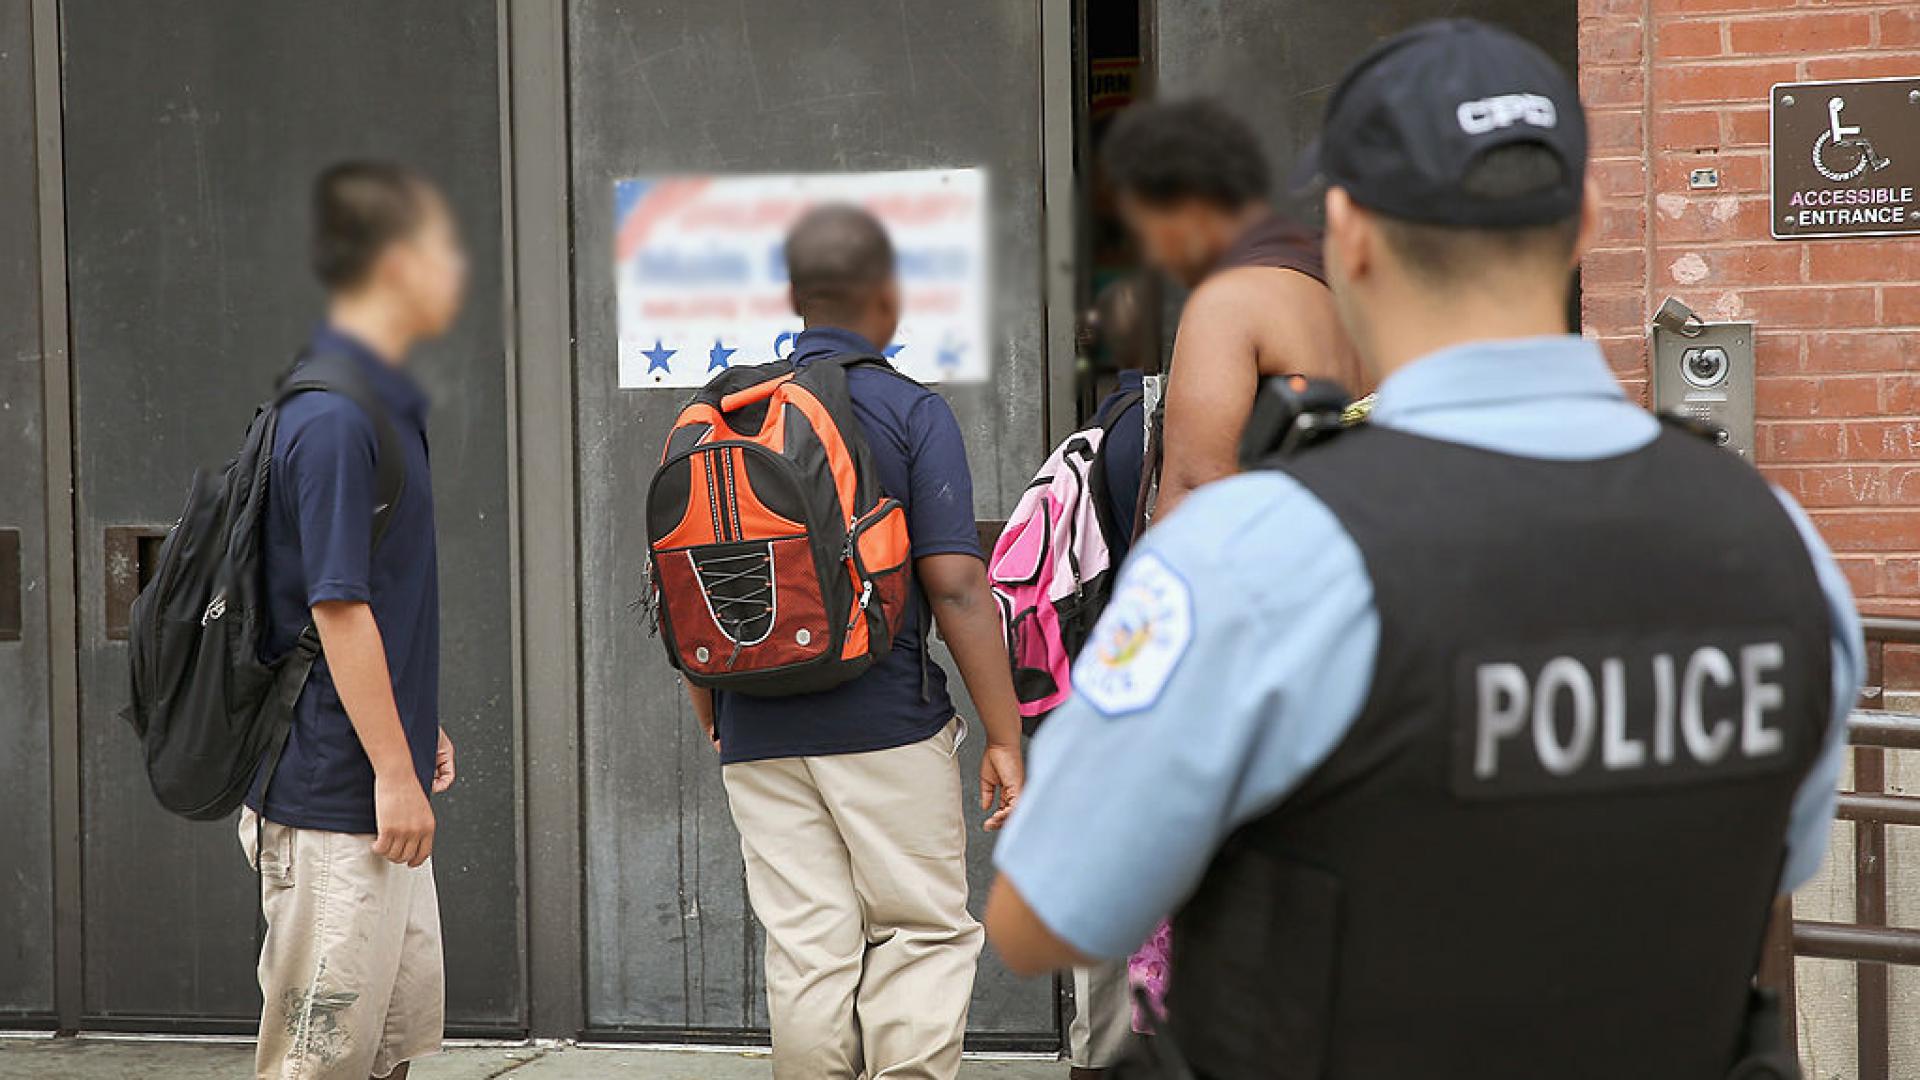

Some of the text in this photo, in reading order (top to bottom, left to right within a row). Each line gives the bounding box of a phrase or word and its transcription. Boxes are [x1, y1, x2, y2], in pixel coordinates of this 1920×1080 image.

[1457, 93, 1557, 134] CPD
[1789, 187, 1914, 206] ACCESSIBLE
[1799, 207, 1904, 226] ENTRANCE
[1473, 642, 1784, 780] POLICE
